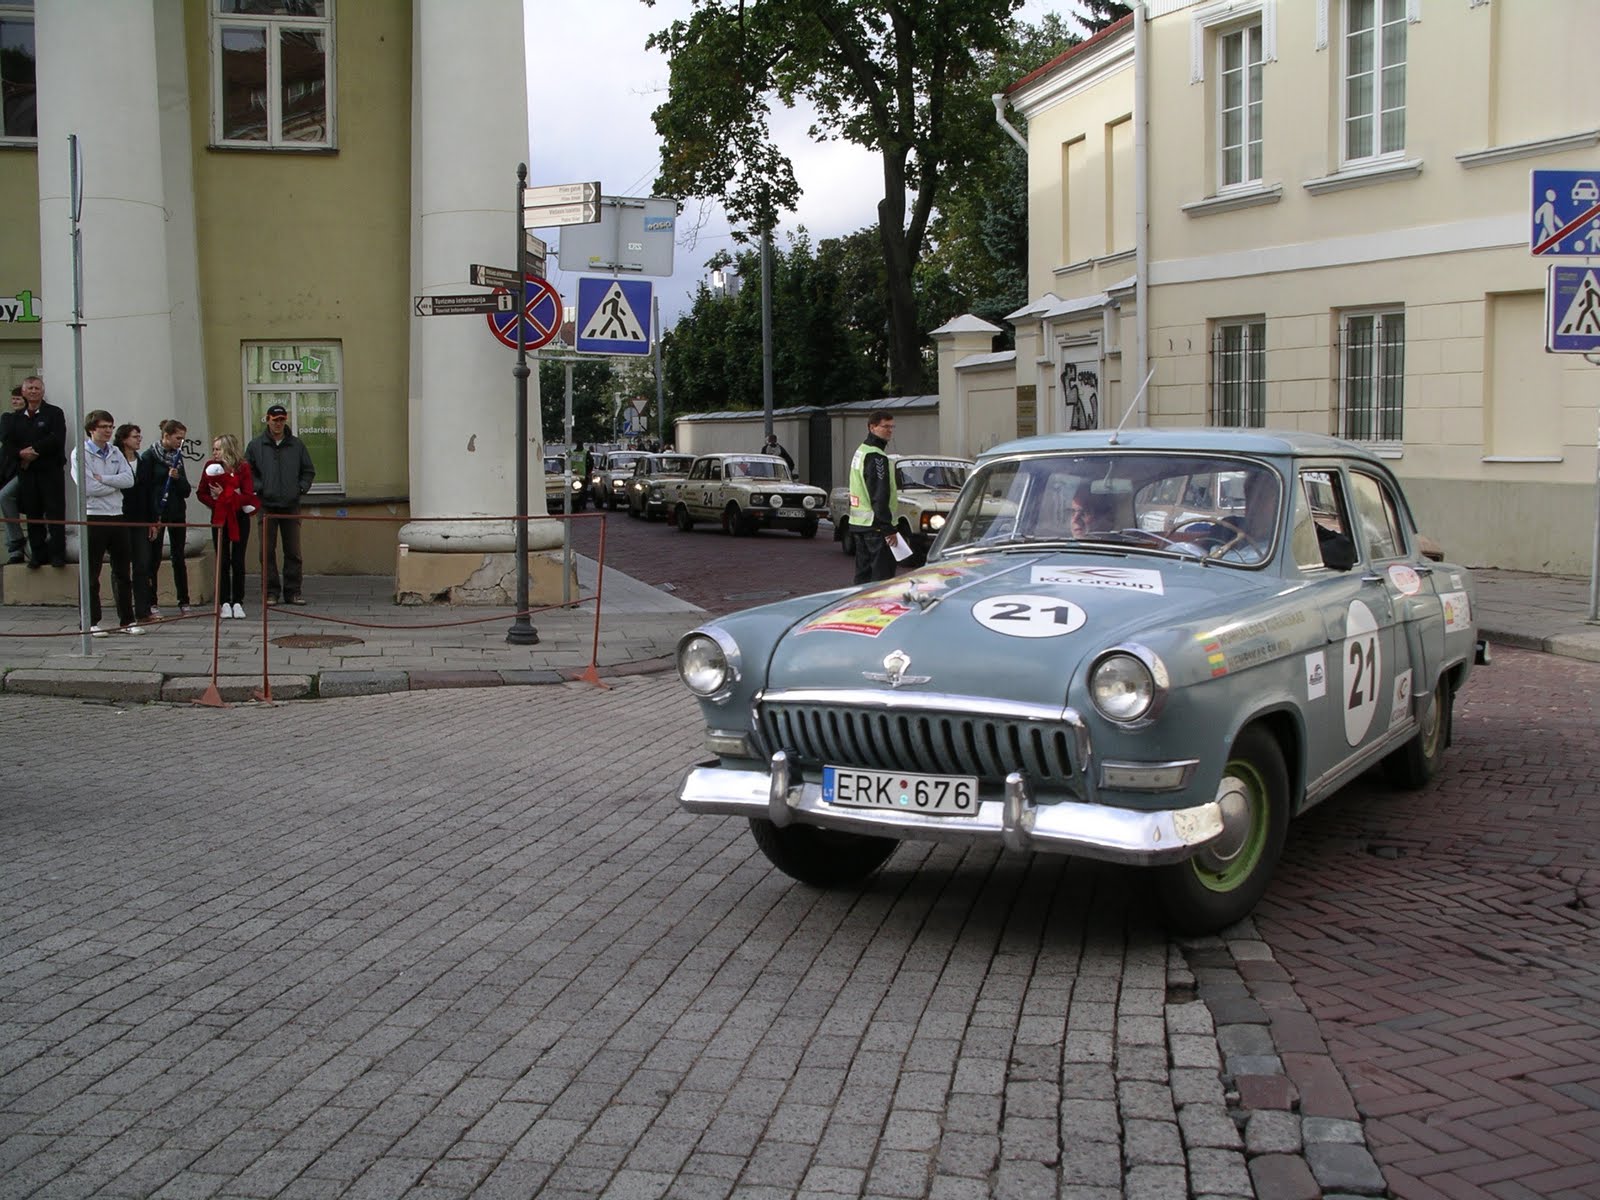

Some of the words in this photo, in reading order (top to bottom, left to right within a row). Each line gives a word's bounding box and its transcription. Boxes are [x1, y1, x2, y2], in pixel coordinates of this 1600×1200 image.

[703, 492, 713, 506] 24
[989, 602, 1069, 625] 21
[1348, 637, 1375, 711] 21
[824, 789, 833, 797] LT
[837, 773, 893, 804] ERK
[915, 779, 970, 810] 676
